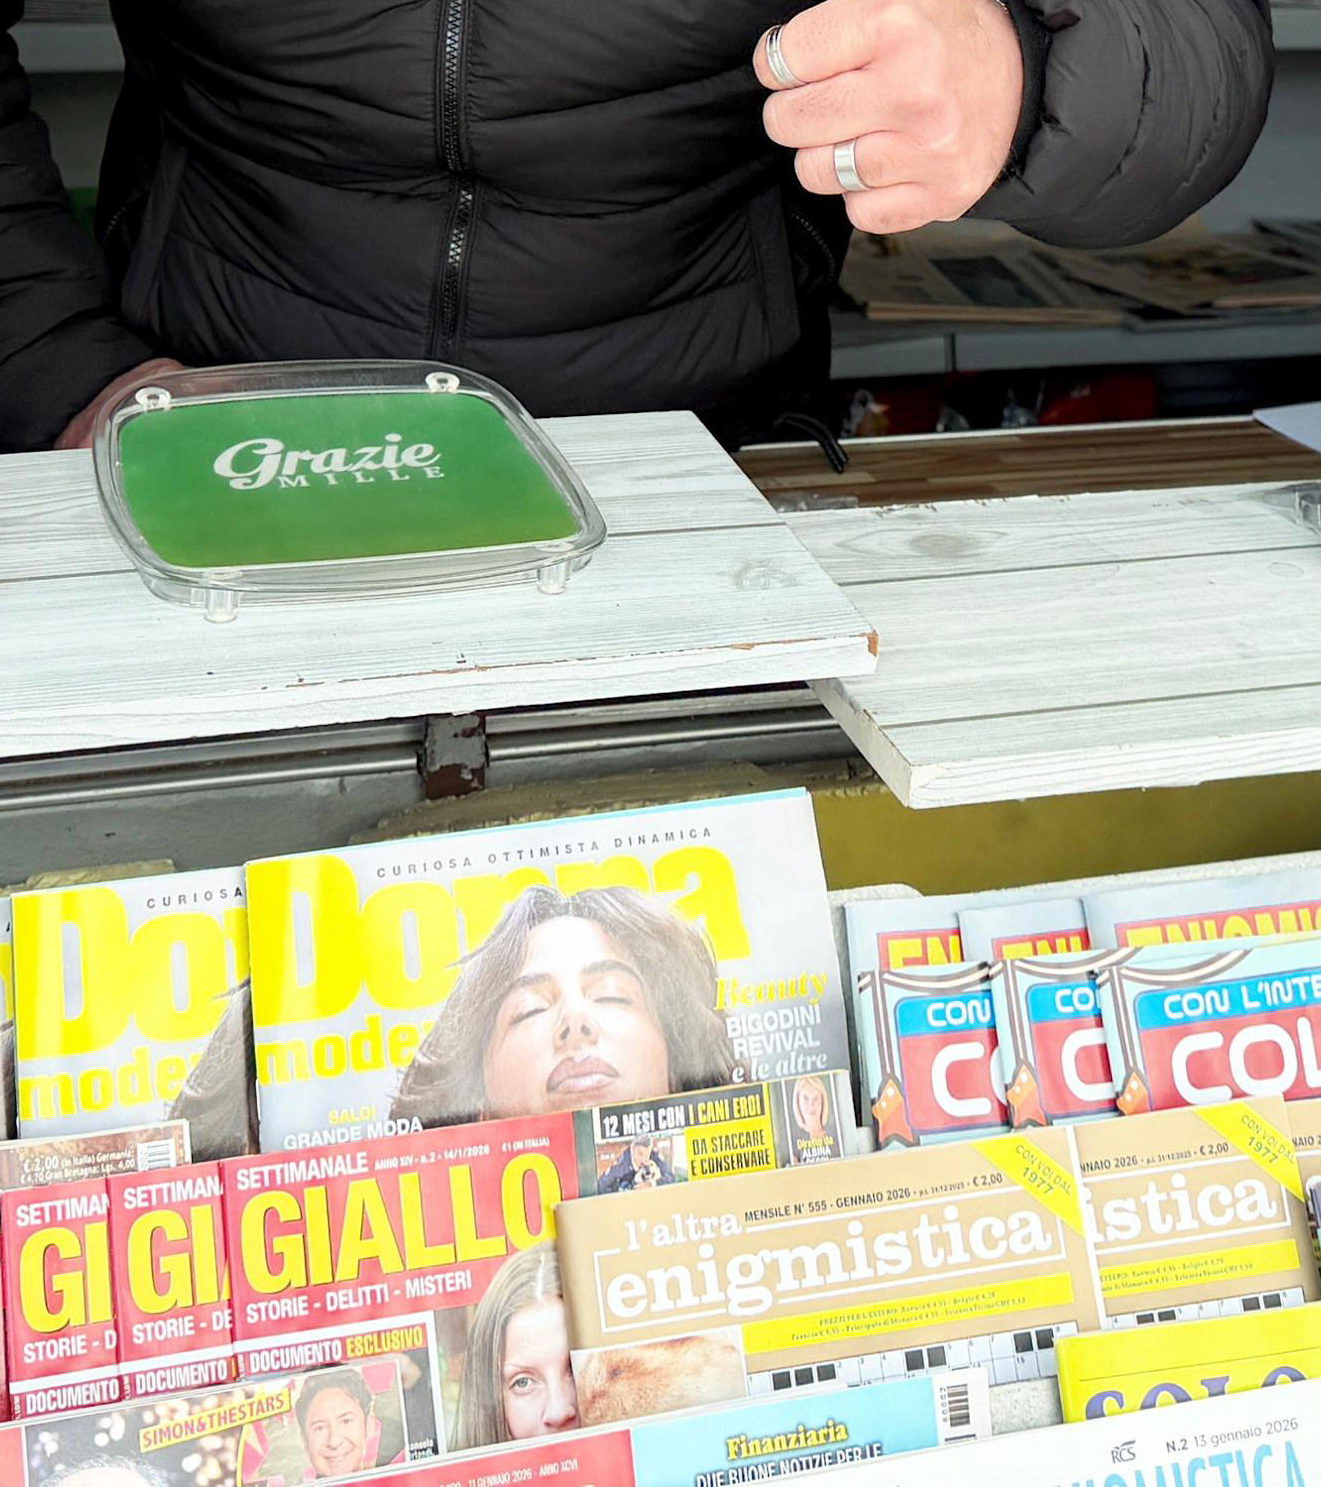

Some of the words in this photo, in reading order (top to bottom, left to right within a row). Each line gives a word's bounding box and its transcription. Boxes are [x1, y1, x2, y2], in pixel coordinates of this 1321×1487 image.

[214, 433, 441, 490] Grazie
[278, 467, 446, 488] MILLE
[377, 857, 472, 879] CURIOSA
[488, 842, 600, 863] OTTIMISTA
[614, 827, 711, 849] DINAMICA
[726, 1004, 821, 1037] BIGODINI
[1164, 992, 1227, 1020] CON
[733, 1028, 820, 1058] REVIVAL
[329, 1106, 375, 1124] SALDI
[283, 1126, 361, 1150] GRANDE
[367, 1117, 423, 1140] MODA
[693, 1139, 706, 1156] DA
[710, 1130, 765, 1154] STACCARE
[236, 1151, 368, 1191] SETTIMANALE
[1022, 1165, 1055, 1198] 1977
[744, 1207, 790, 1222] MENSILE
[807, 1200, 828, 1213] 555
[836, 1189, 883, 1208] GENNAIO
[887, 1185, 911, 1201] 2026
[981, 1171, 1003, 1186] 2,00
[242, 1152, 562, 1295] GIALLO
[607, 1207, 1050, 1317] enigmistica
[246, 1294, 307, 1324] STORIE
[326, 1282, 389, 1311] DELITTI
[405, 1268, 472, 1299] MISTERI
[23, 1333, 86, 1363] STORIE
[249, 1339, 342, 1375] DOCUMENTO
[346, 1325, 423, 1357] ESCLUSIVO
[136, 1360, 229, 1395] DOCUMENTO
[26, 1378, 119, 1414] DOCUMENTO
[726, 1418, 848, 1462] Finanziaria
[1194, 1433, 1207, 1447] 13
[1210, 1424, 1261, 1447] gennaio
[1264, 1416, 1299, 1435] 2026
[1111, 1444, 1136, 1463] RCS
